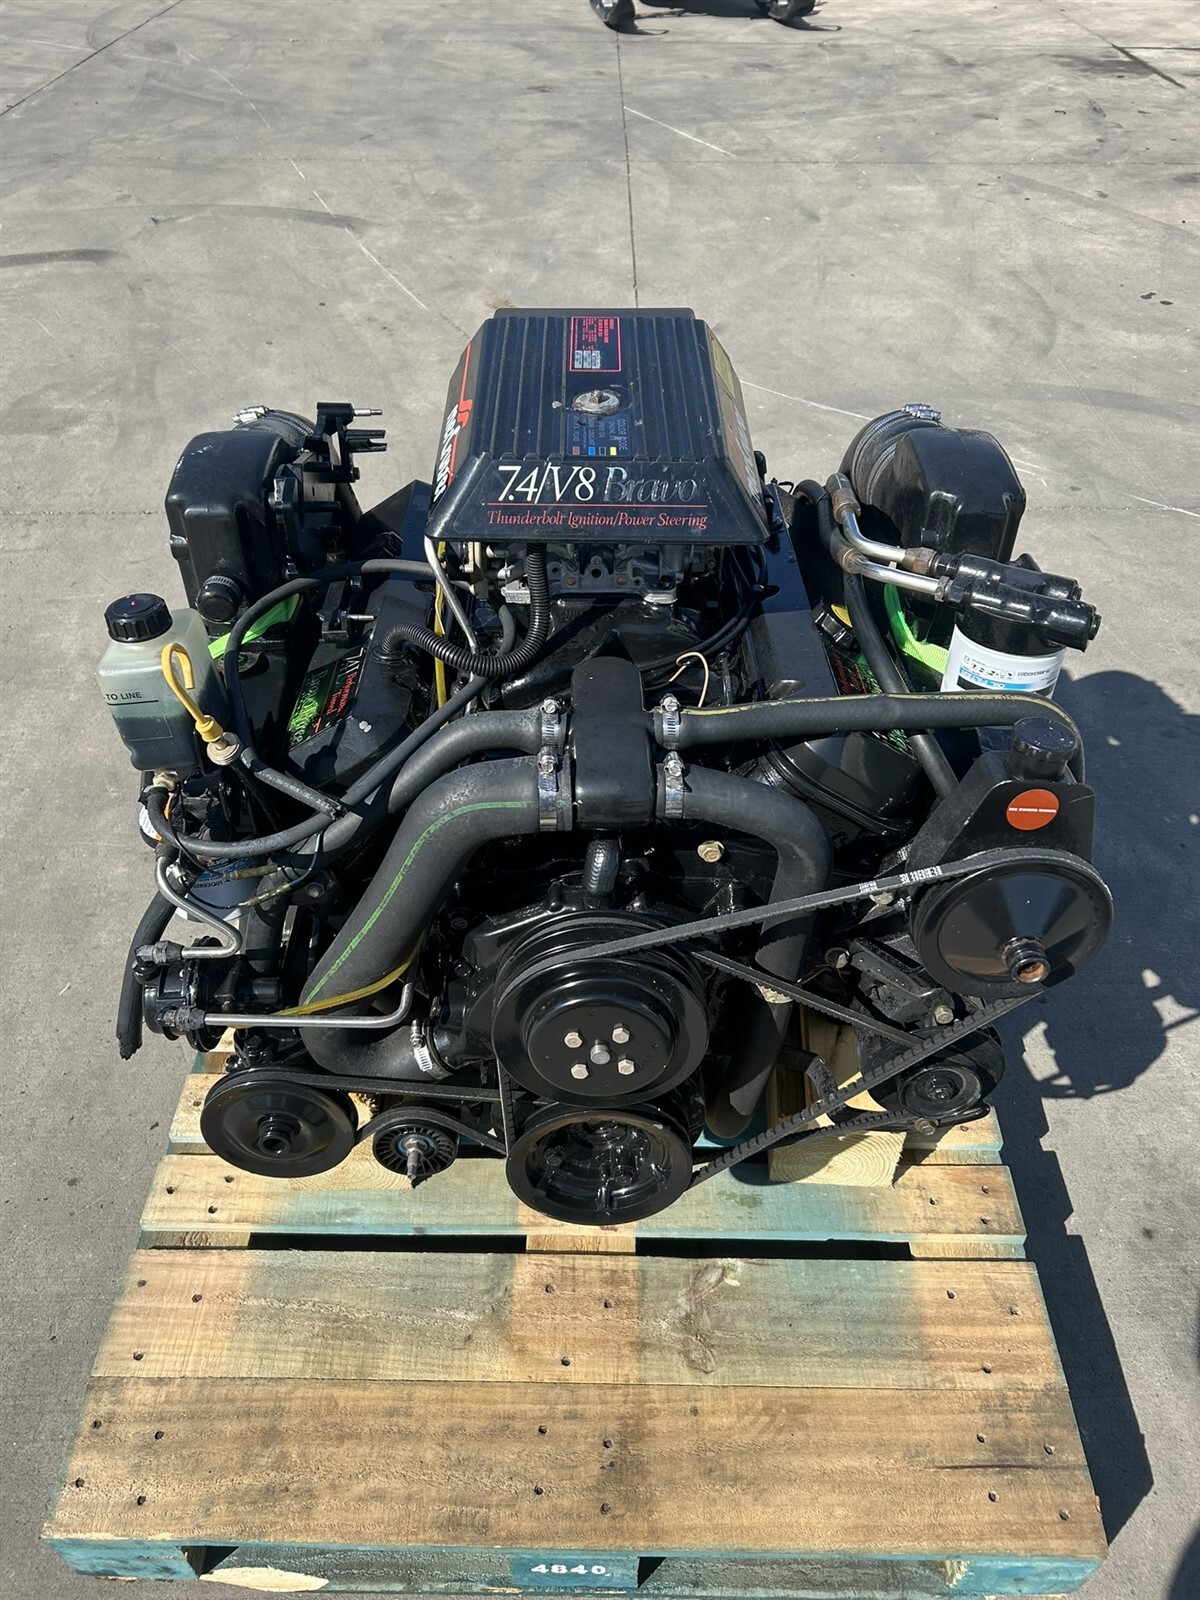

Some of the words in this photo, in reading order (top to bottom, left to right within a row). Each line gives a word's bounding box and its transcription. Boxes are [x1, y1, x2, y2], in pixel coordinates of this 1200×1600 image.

[603, 466, 698, 502] Bravo
[487, 511, 563, 526] Thunderbolt
[567, 511, 655, 528] Ignition/Power
[657, 512, 708, 529] Steering
[105, 693, 118, 701] TO
[120, 692, 142, 700] LINE
